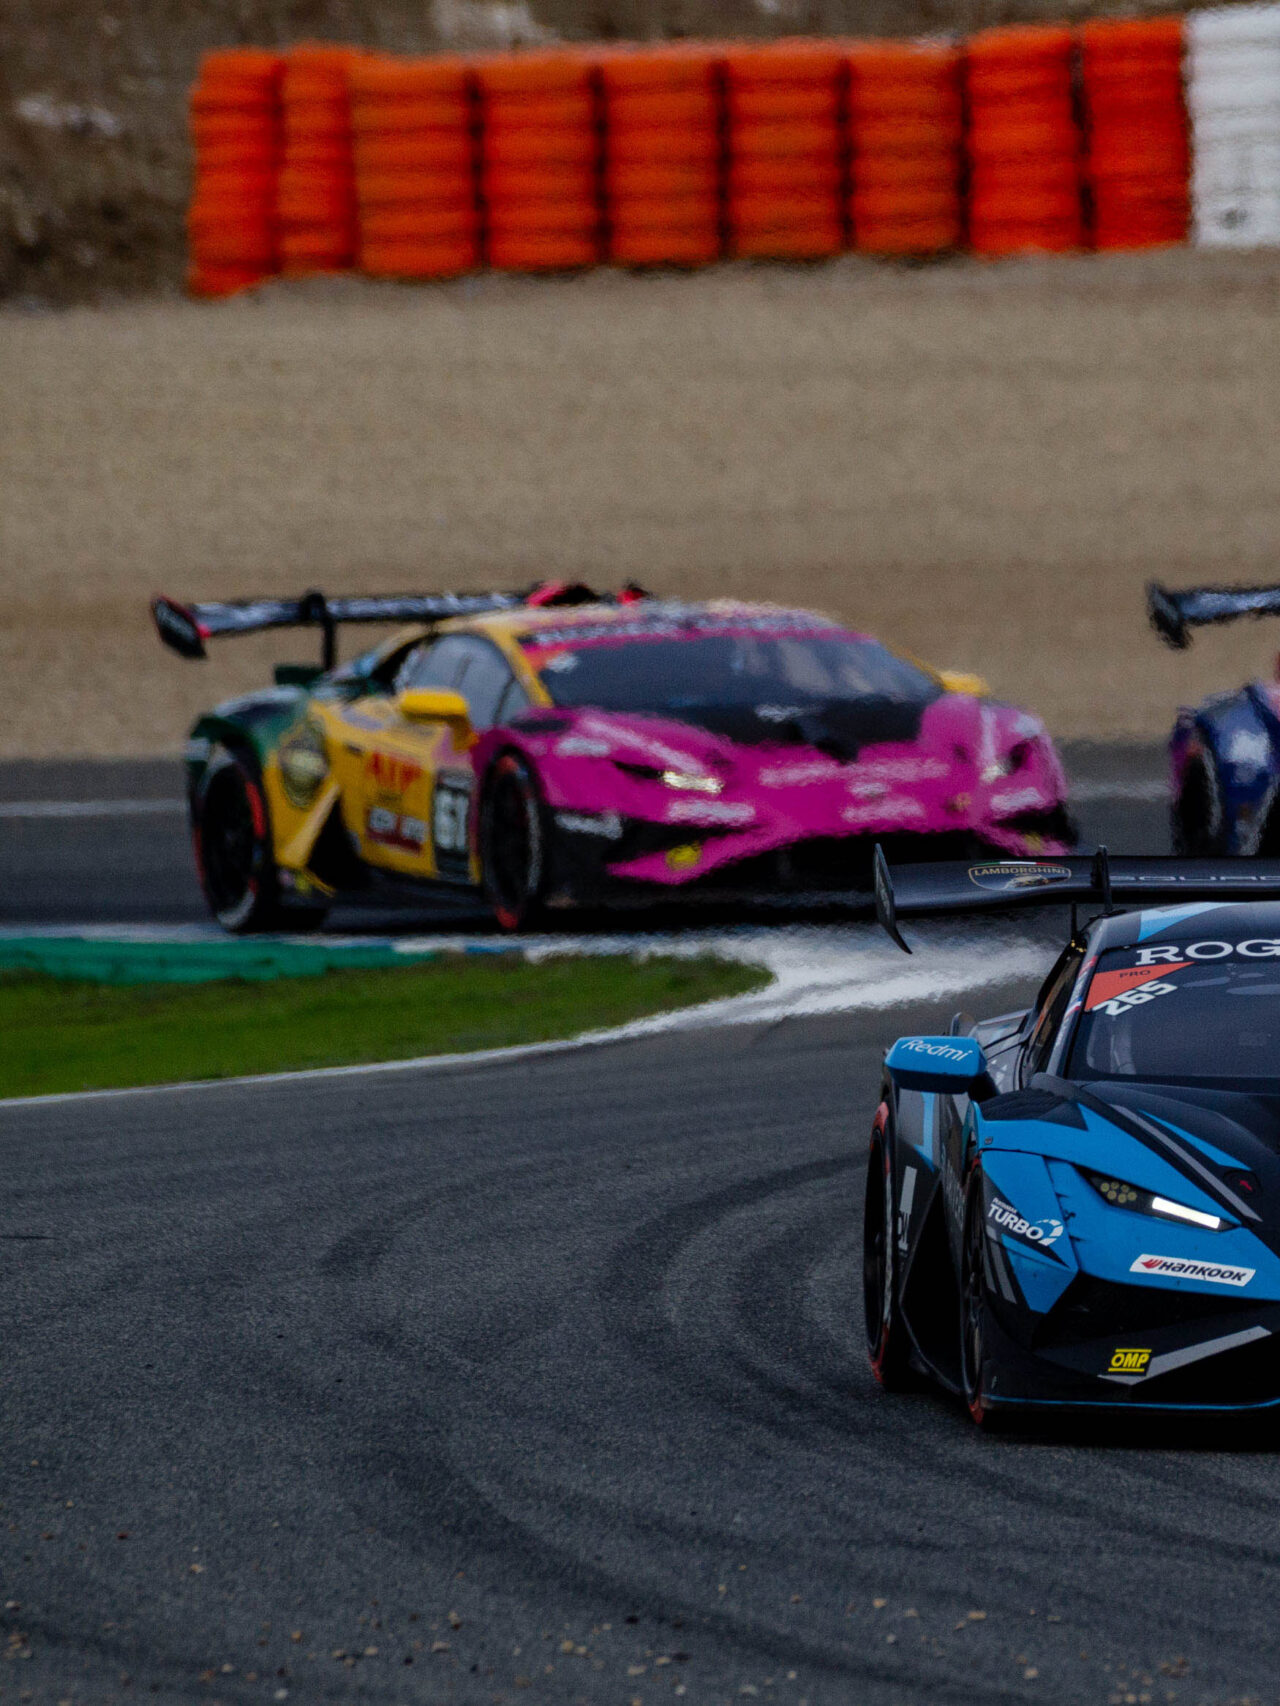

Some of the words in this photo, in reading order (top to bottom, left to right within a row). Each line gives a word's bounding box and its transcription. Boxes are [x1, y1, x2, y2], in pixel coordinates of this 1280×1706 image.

[974, 866, 1066, 876] LAMBORGHINI
[1119, 969, 1151, 978] PRO
[1092, 980, 1179, 1017] 265
[900, 1039, 974, 1062] Redmi
[1110, 1353, 1150, 1368] OMP
